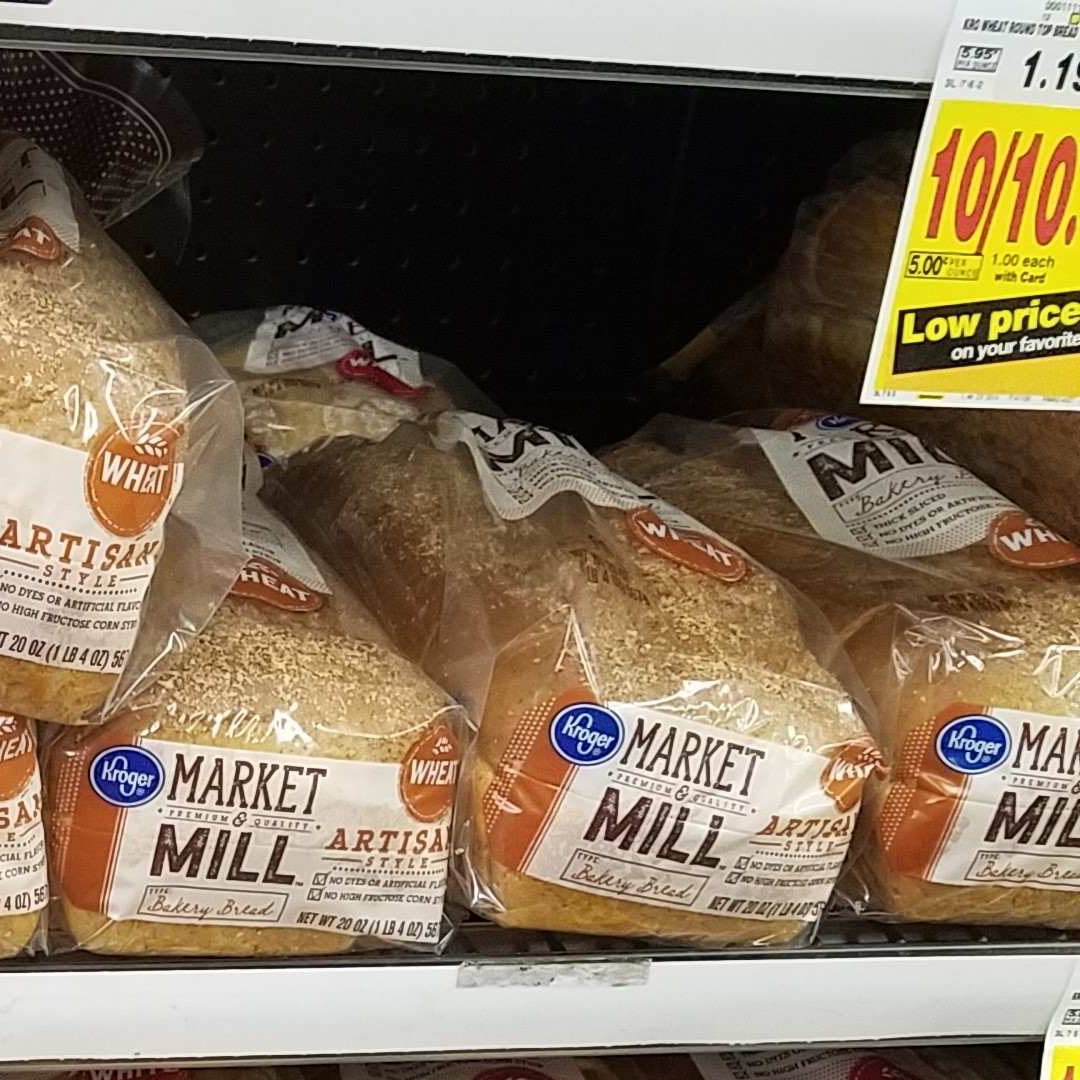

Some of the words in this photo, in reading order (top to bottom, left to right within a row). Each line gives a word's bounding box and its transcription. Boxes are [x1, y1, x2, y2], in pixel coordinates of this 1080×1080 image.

[992, 254, 1019, 268] 1.00
[1022, 256, 1054, 268] each
[995, 272, 1017, 283] with
[1020, 272, 1046, 283] Card
[901, 312, 981, 344] Low
[951, 347, 974, 360] on
[976, 343, 1017, 361] your
[0, 583, 16, 593] NO
[18, 588, 45, 601] DYES
[47, 595, 62, 604] OR
[12, 604, 39, 619] HIGH
[41, 612, 92, 628] FRUCTOSE
[93, 621, 119, 630] CORN
[9, 635, 27, 652] 20
[28, 639, 46, 657] OZ
[562, 714, 615, 754] Kroger
[947, 725, 1002, 763] Kroger
[620, 718, 765, 797] MARKET
[101, 757, 155, 796] Kroger
[167, 753, 327, 814] MARKET
[583, 787, 724, 869] MILL
[149, 823, 296, 886] MILL
